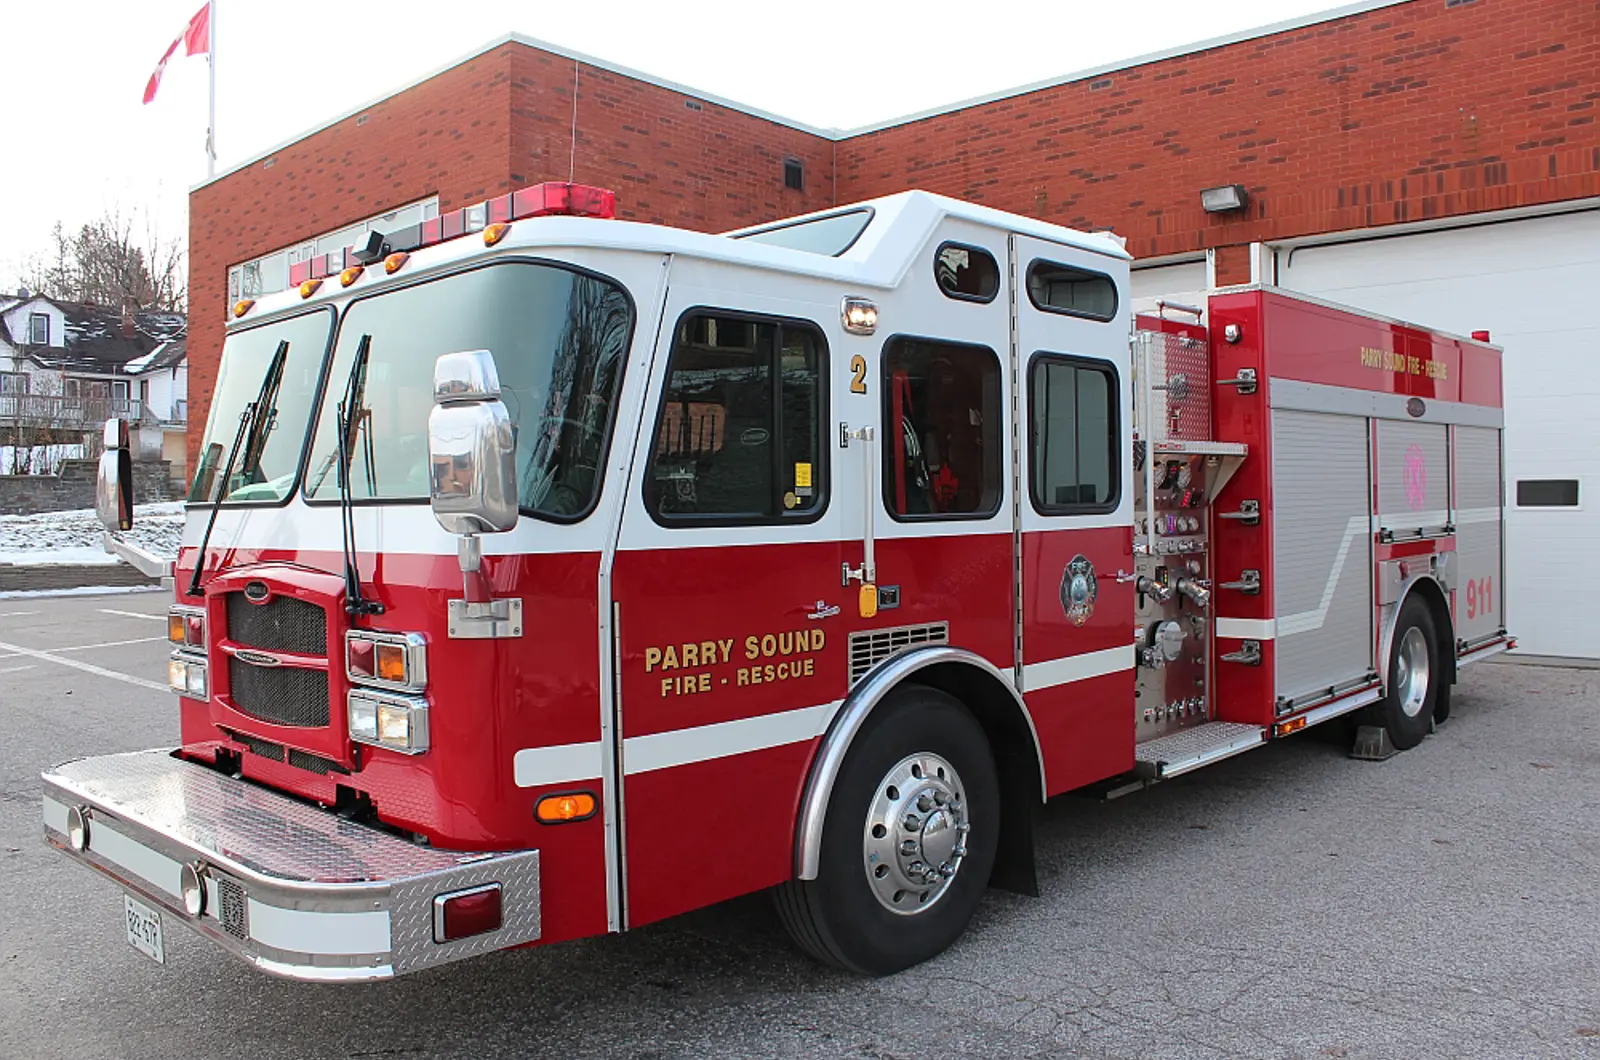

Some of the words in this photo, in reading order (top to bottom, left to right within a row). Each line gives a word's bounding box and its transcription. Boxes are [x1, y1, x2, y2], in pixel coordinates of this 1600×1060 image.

[850, 354, 867, 394] 2
[1360, 346, 1382, 369] PARRY
[1384, 350, 1406, 374] SOUND
[1407, 355, 1420, 375] FIRE
[1467, 575, 1493, 620] 911
[645, 638, 735, 673] PARRY
[745, 628, 826, 660] SOUND
[661, 672, 712, 697] FIRE
[736, 658, 814, 687] RESCUE
